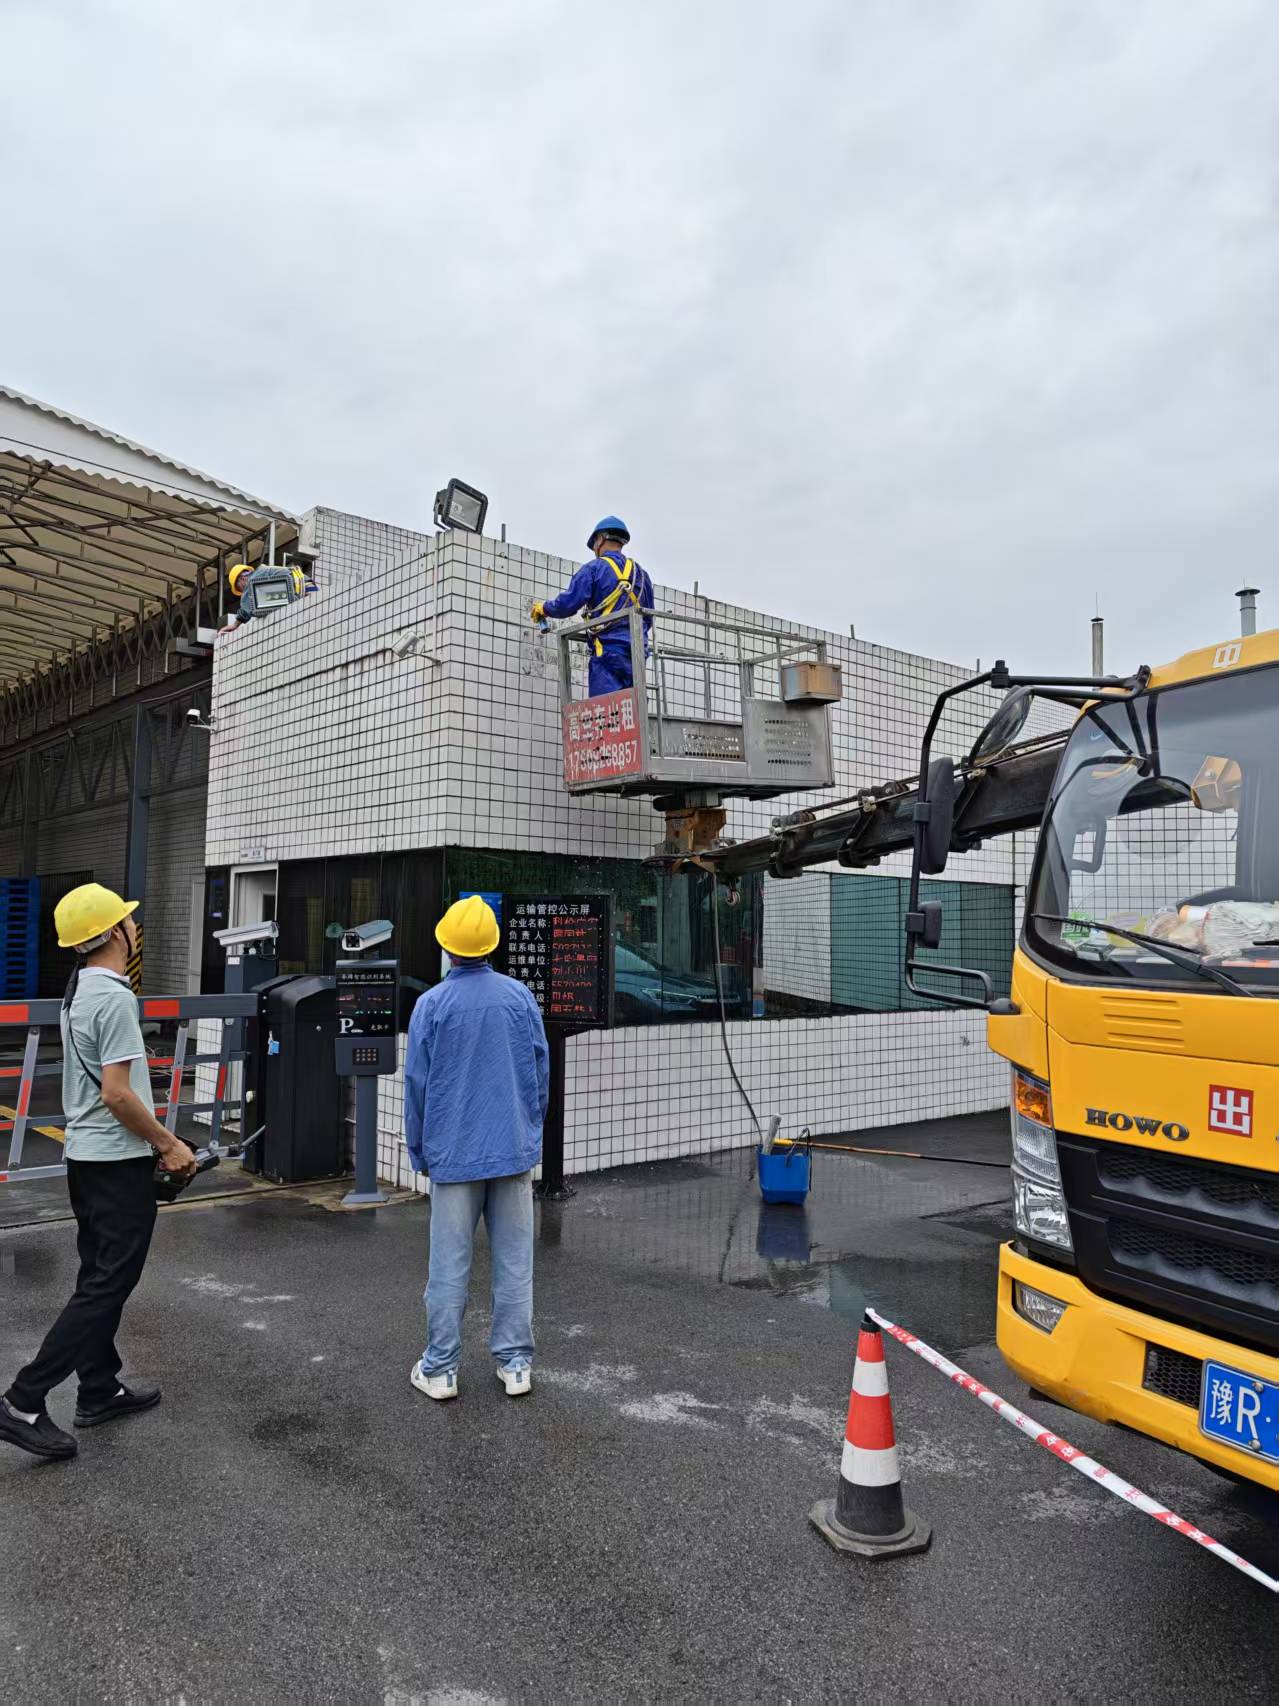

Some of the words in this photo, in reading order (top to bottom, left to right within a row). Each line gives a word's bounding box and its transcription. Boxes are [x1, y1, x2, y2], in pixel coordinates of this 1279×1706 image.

[516, 904, 590, 915] 运输管控公示屏
[339, 1018, 354, 1034] P
[1085, 1107, 1190, 1142] HOWO
